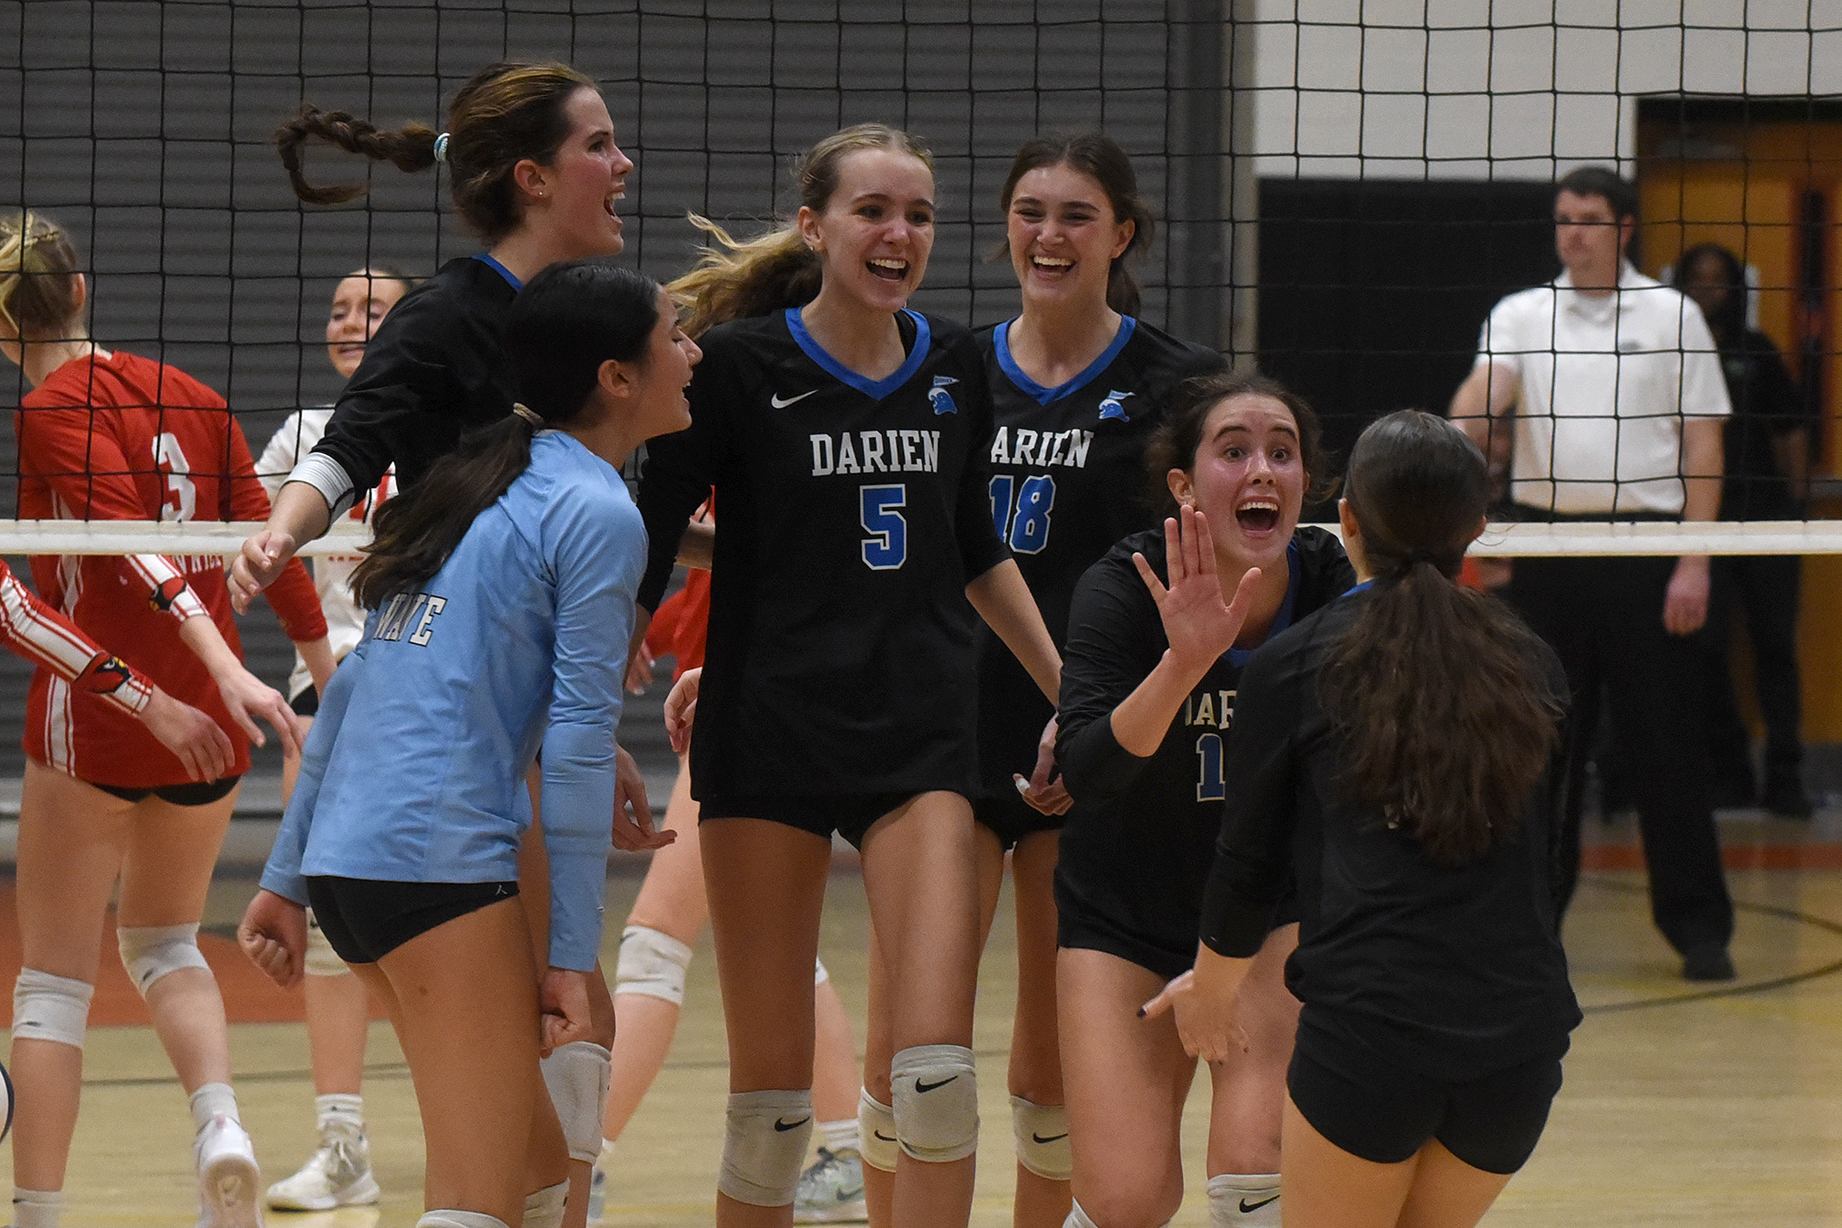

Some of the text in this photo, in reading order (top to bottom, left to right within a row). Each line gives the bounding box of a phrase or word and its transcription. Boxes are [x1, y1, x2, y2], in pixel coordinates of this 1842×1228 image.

[152, 432, 196, 521] 3
[810, 430, 940, 476] DARIEN
[859, 484, 907, 571] 5
[988, 474, 1057, 555] 18
